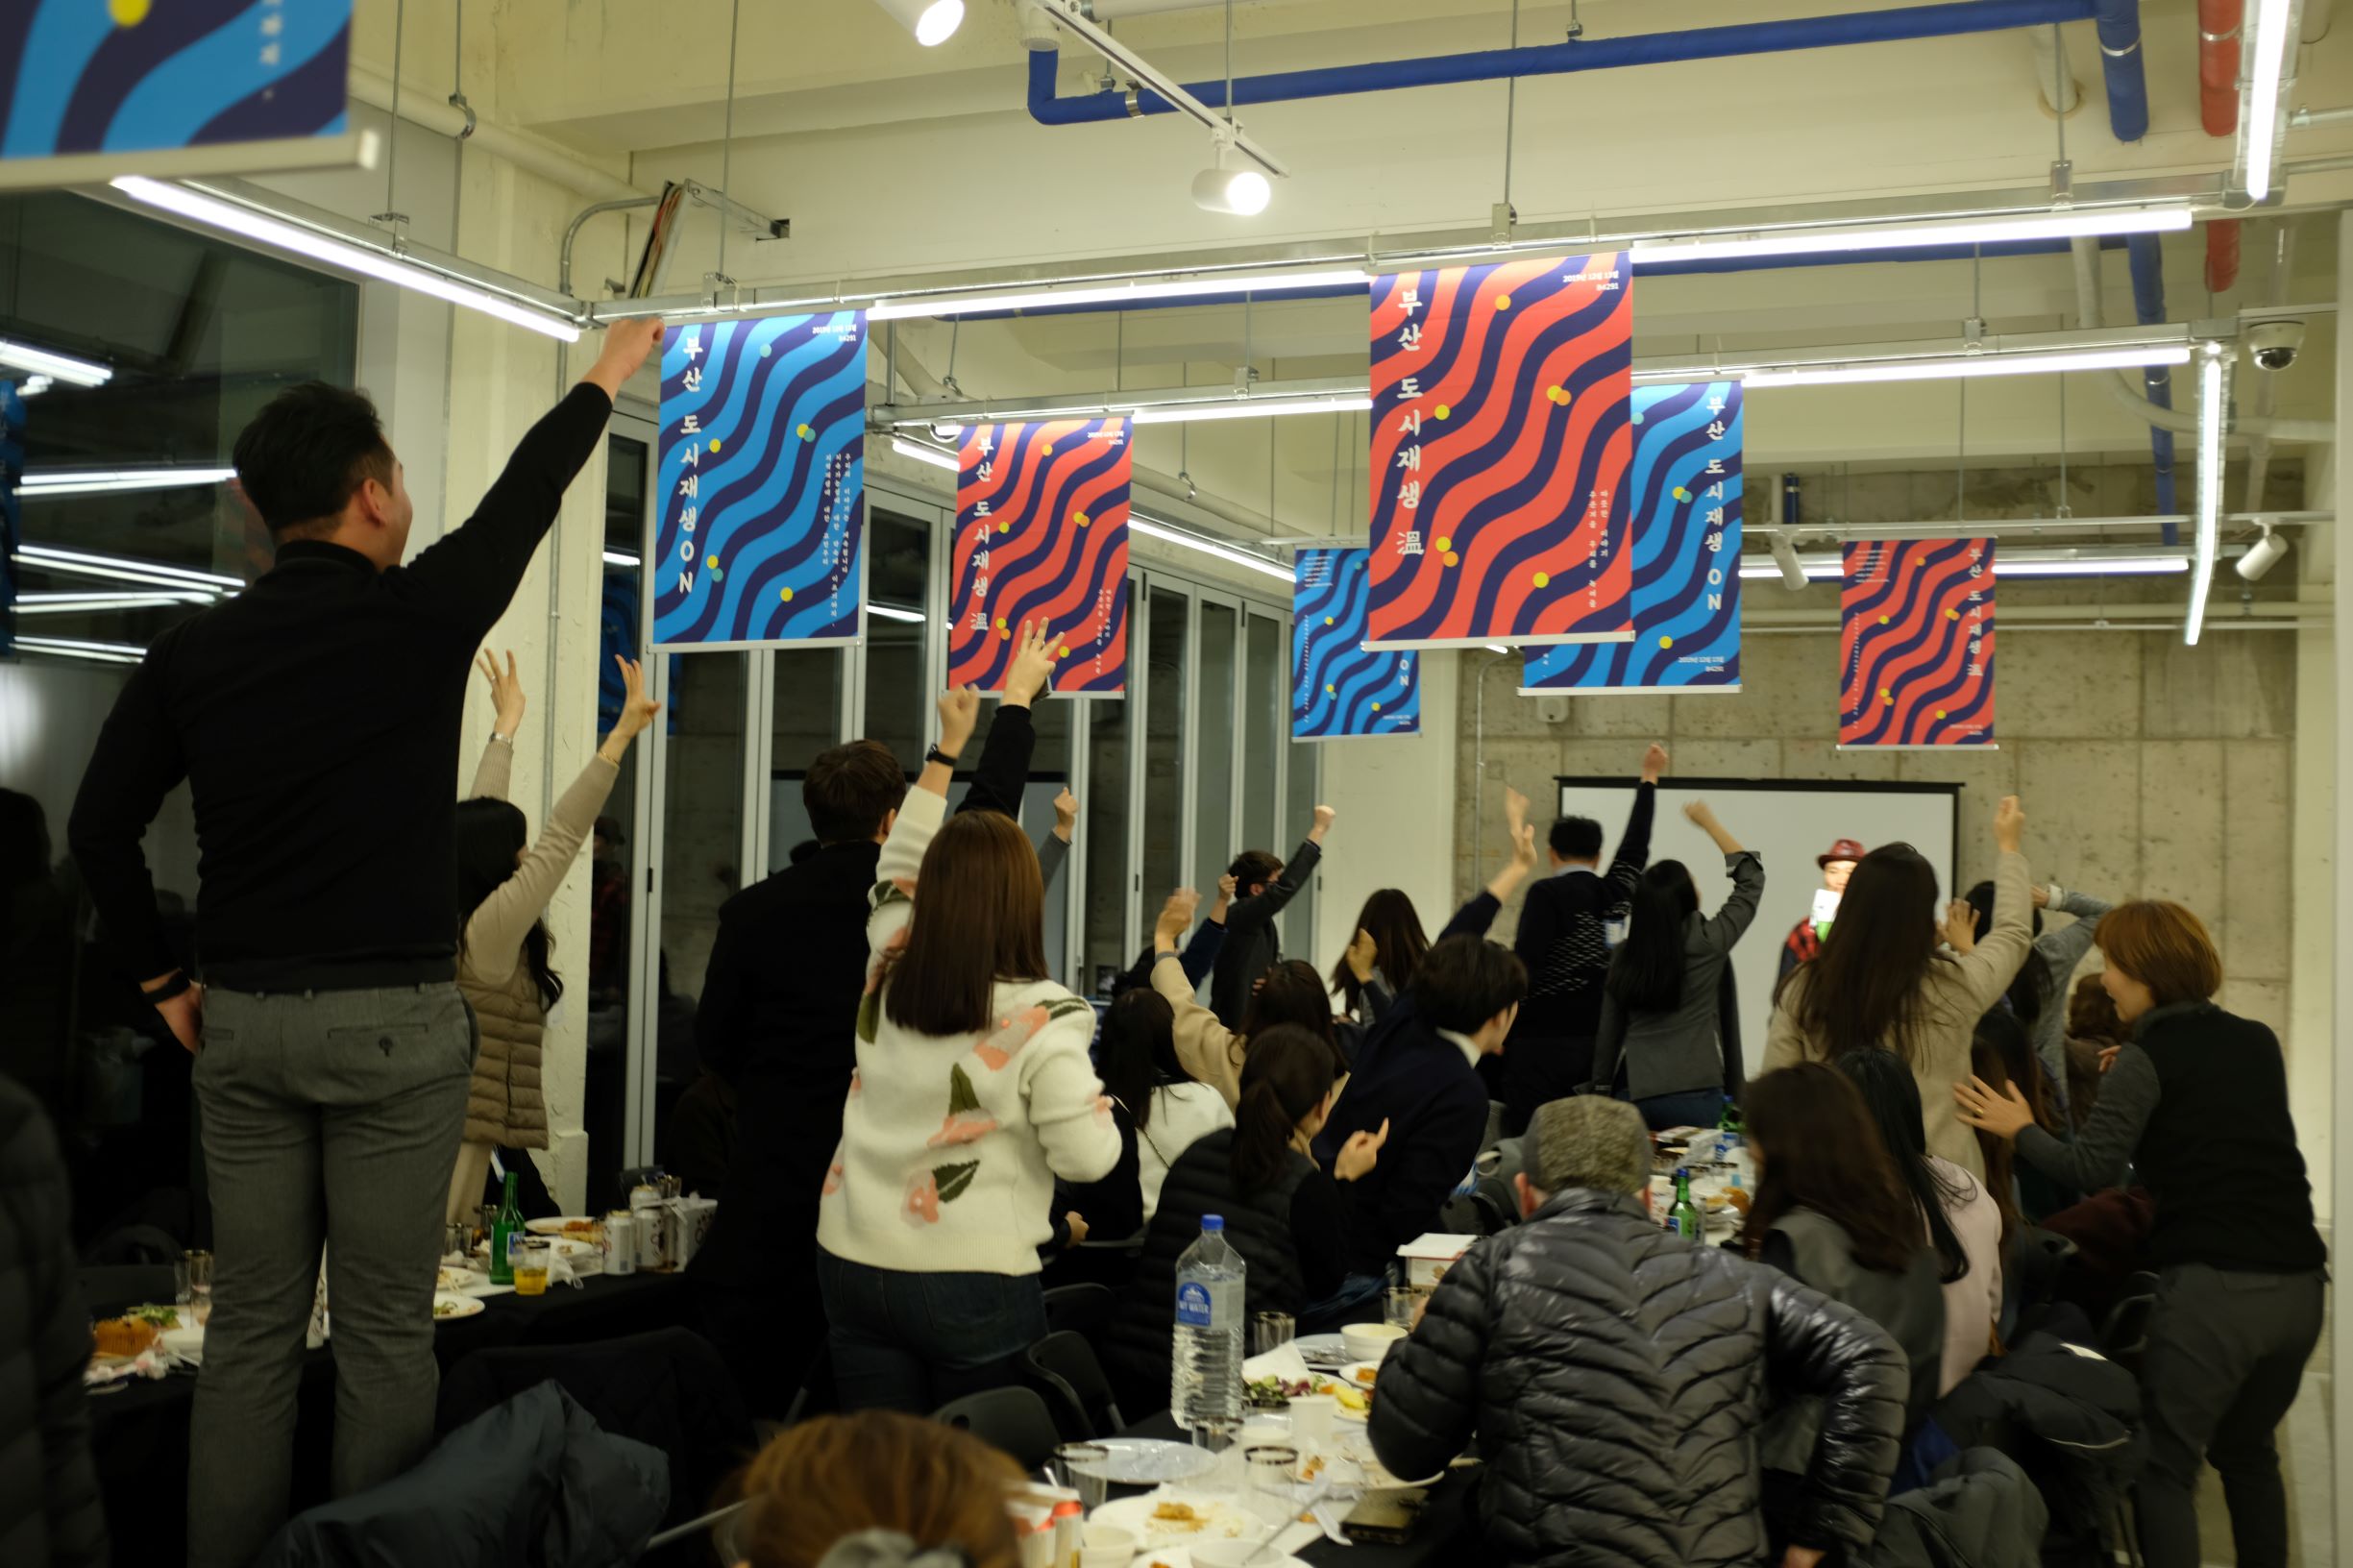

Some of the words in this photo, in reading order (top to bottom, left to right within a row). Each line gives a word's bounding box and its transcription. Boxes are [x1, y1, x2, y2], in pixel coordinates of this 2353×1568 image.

[1397, 289, 1423, 352] 부산
[682, 336, 703, 393] 부산
[1397, 378, 1423, 509] 도시재생
[1706, 395, 1726, 441] 부산
[976, 436, 993, 482] 부산
[1705, 458, 1726, 552] 도시재생
[971, 501, 992, 598] 도시재생
[1969, 548, 1983, 578] 부산
[1707, 568, 1723, 610] ON
[1968, 590, 1983, 654] 도시재생
[1189, 1302, 1209, 1314] WATER
